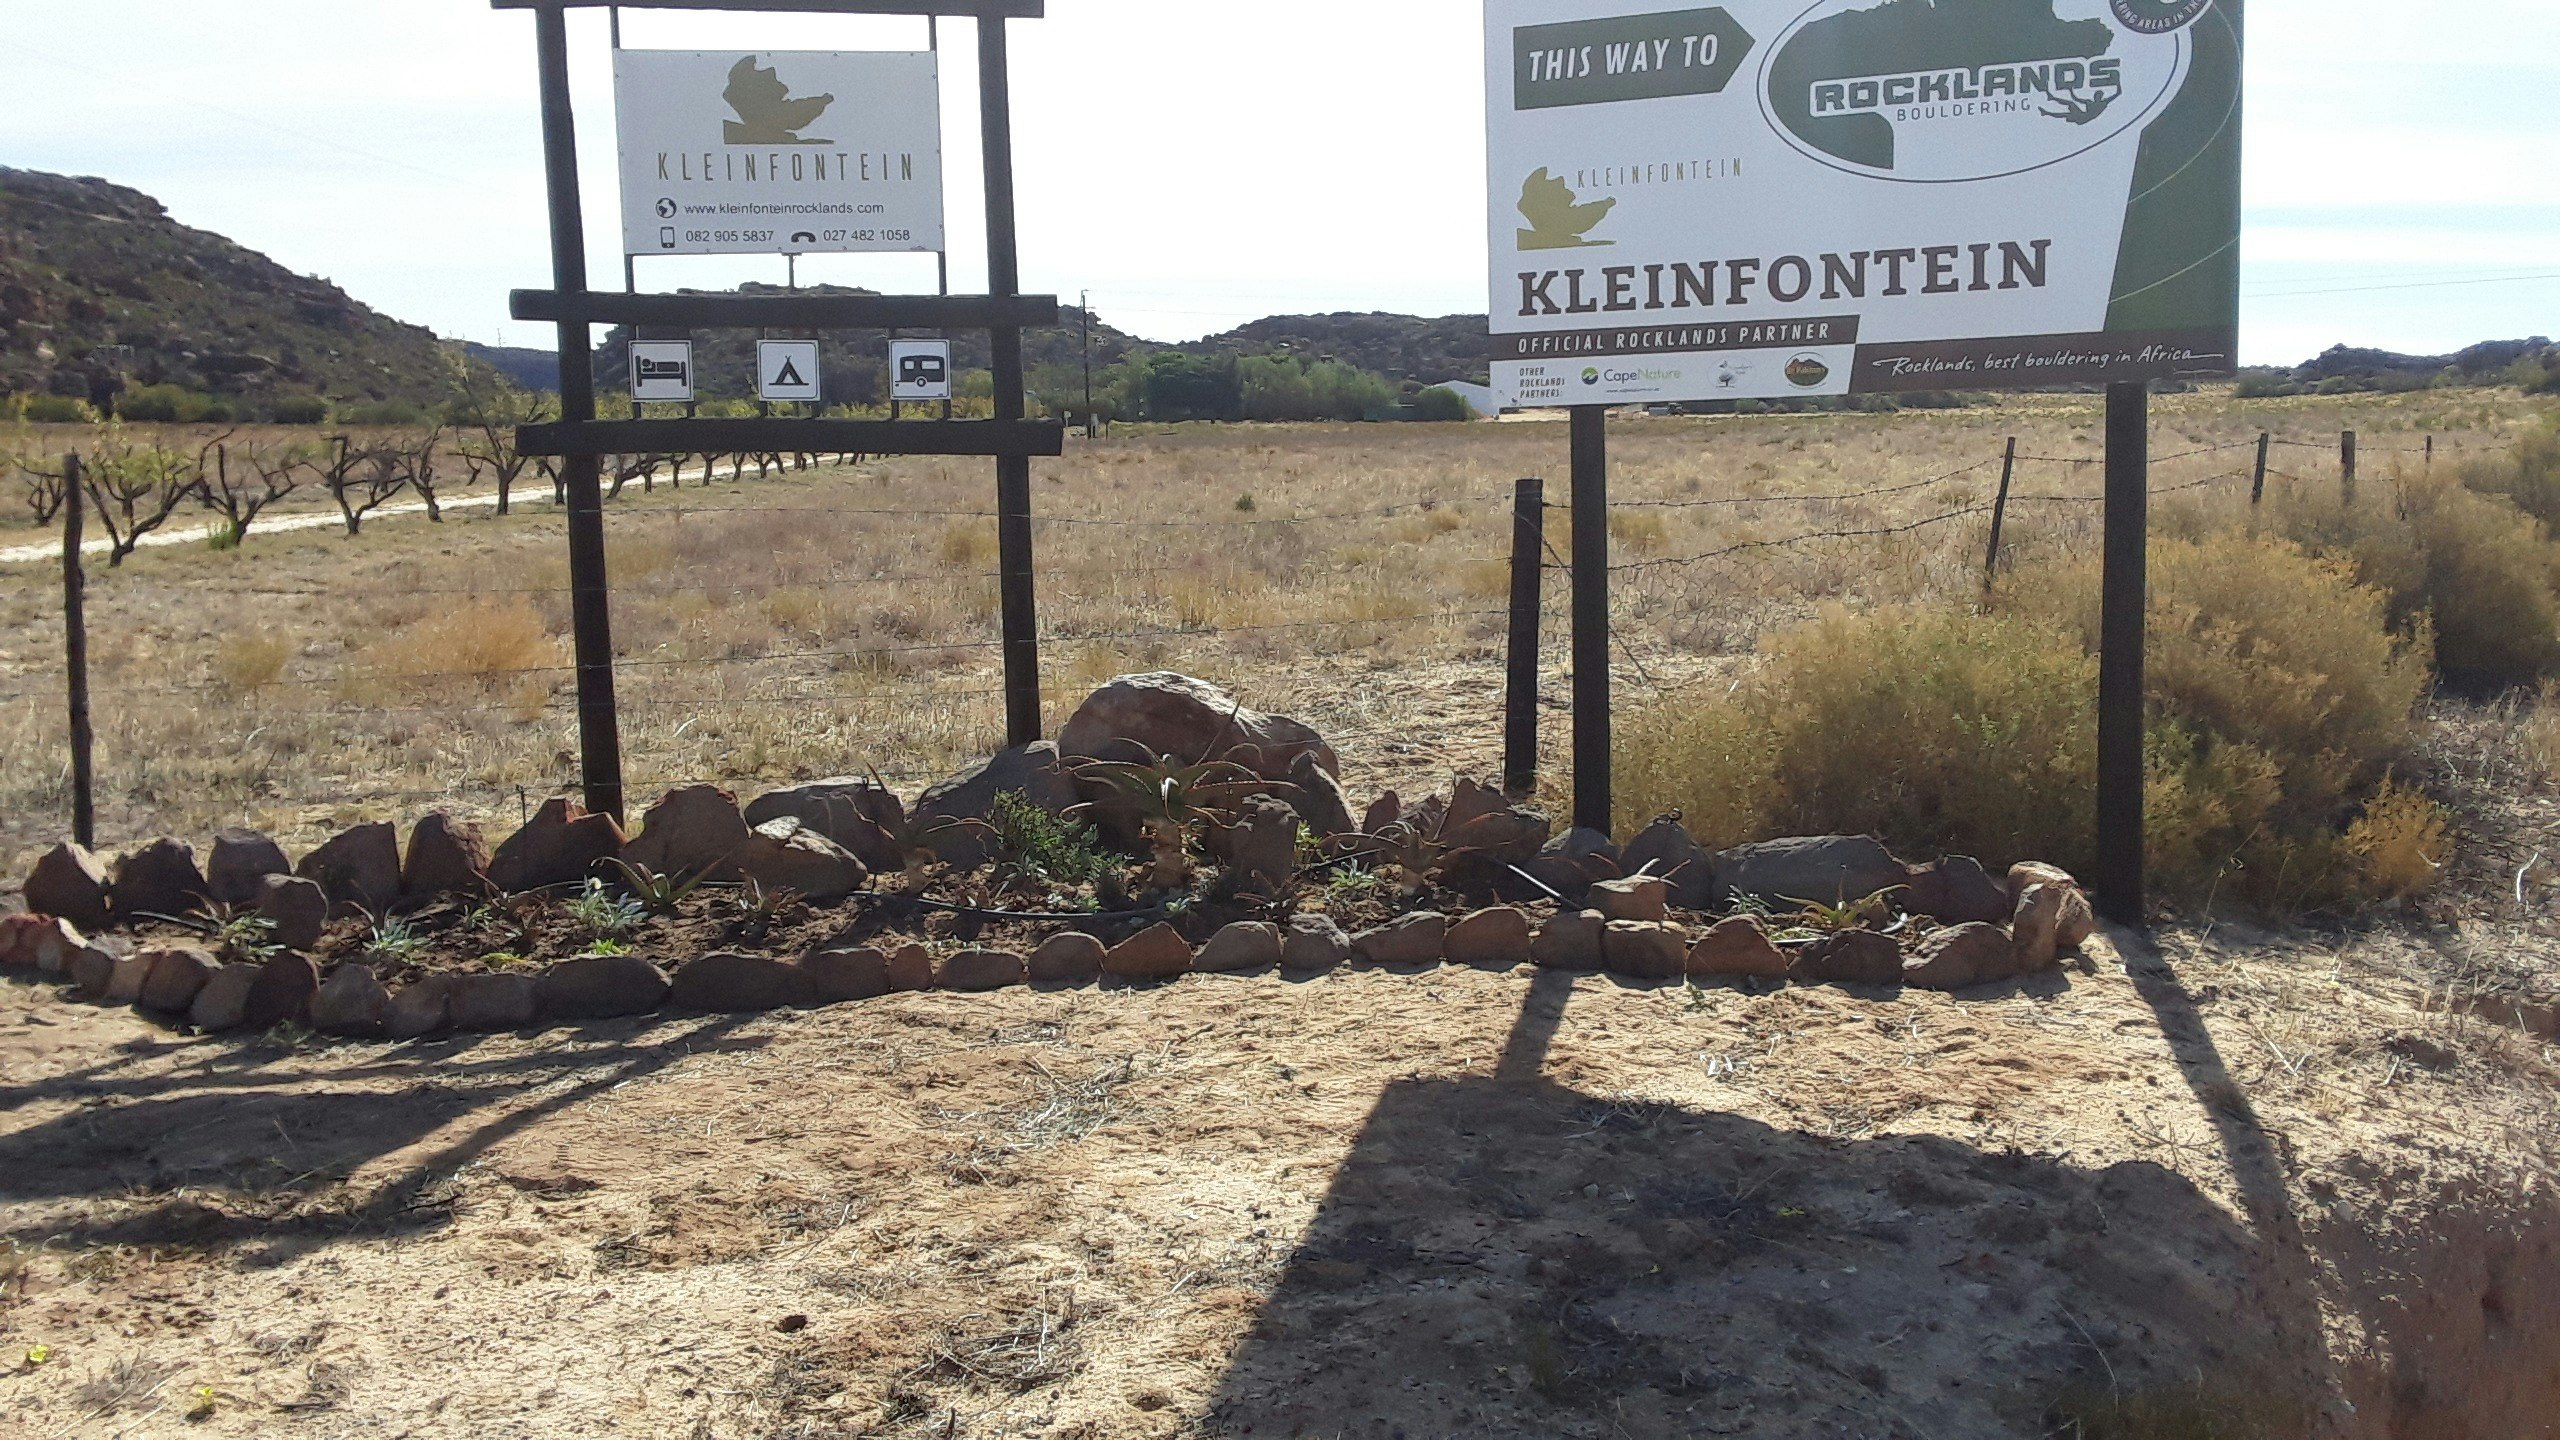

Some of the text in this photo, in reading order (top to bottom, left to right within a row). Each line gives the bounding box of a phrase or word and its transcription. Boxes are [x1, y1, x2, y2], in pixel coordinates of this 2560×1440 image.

[2137, 18, 2171, 30] AREAS
[2172, 12, 2185, 24] IN
[1528, 34, 1719, 82] THIS WAY TO
[1814, 57, 2121, 112] ROCKLANDS
[1896, 97, 2032, 122] BOULDERING
[657, 152, 913, 182] KLEINFONTEIN
[1577, 157, 1741, 188] KLEINFONTEIN
[684, 202, 884, 215] www.kleinfonteinrocklands.com
[685, 230, 774, 242] 082 905 5837
[823, 230, 910, 241] 027 482 1058
[1517, 238, 2053, 317] KLEINFONTEIN
[1518, 322, 1830, 353] OFFICIAL ROCKLANDS PARTNER
[1519, 367, 1545, 376] OTHER
[1873, 345, 2224, 378] Rocklands, best bouldering in Africa
[1519, 377, 1565, 387] ROCKLANDS
[1603, 367, 1681, 384] CapeNature
